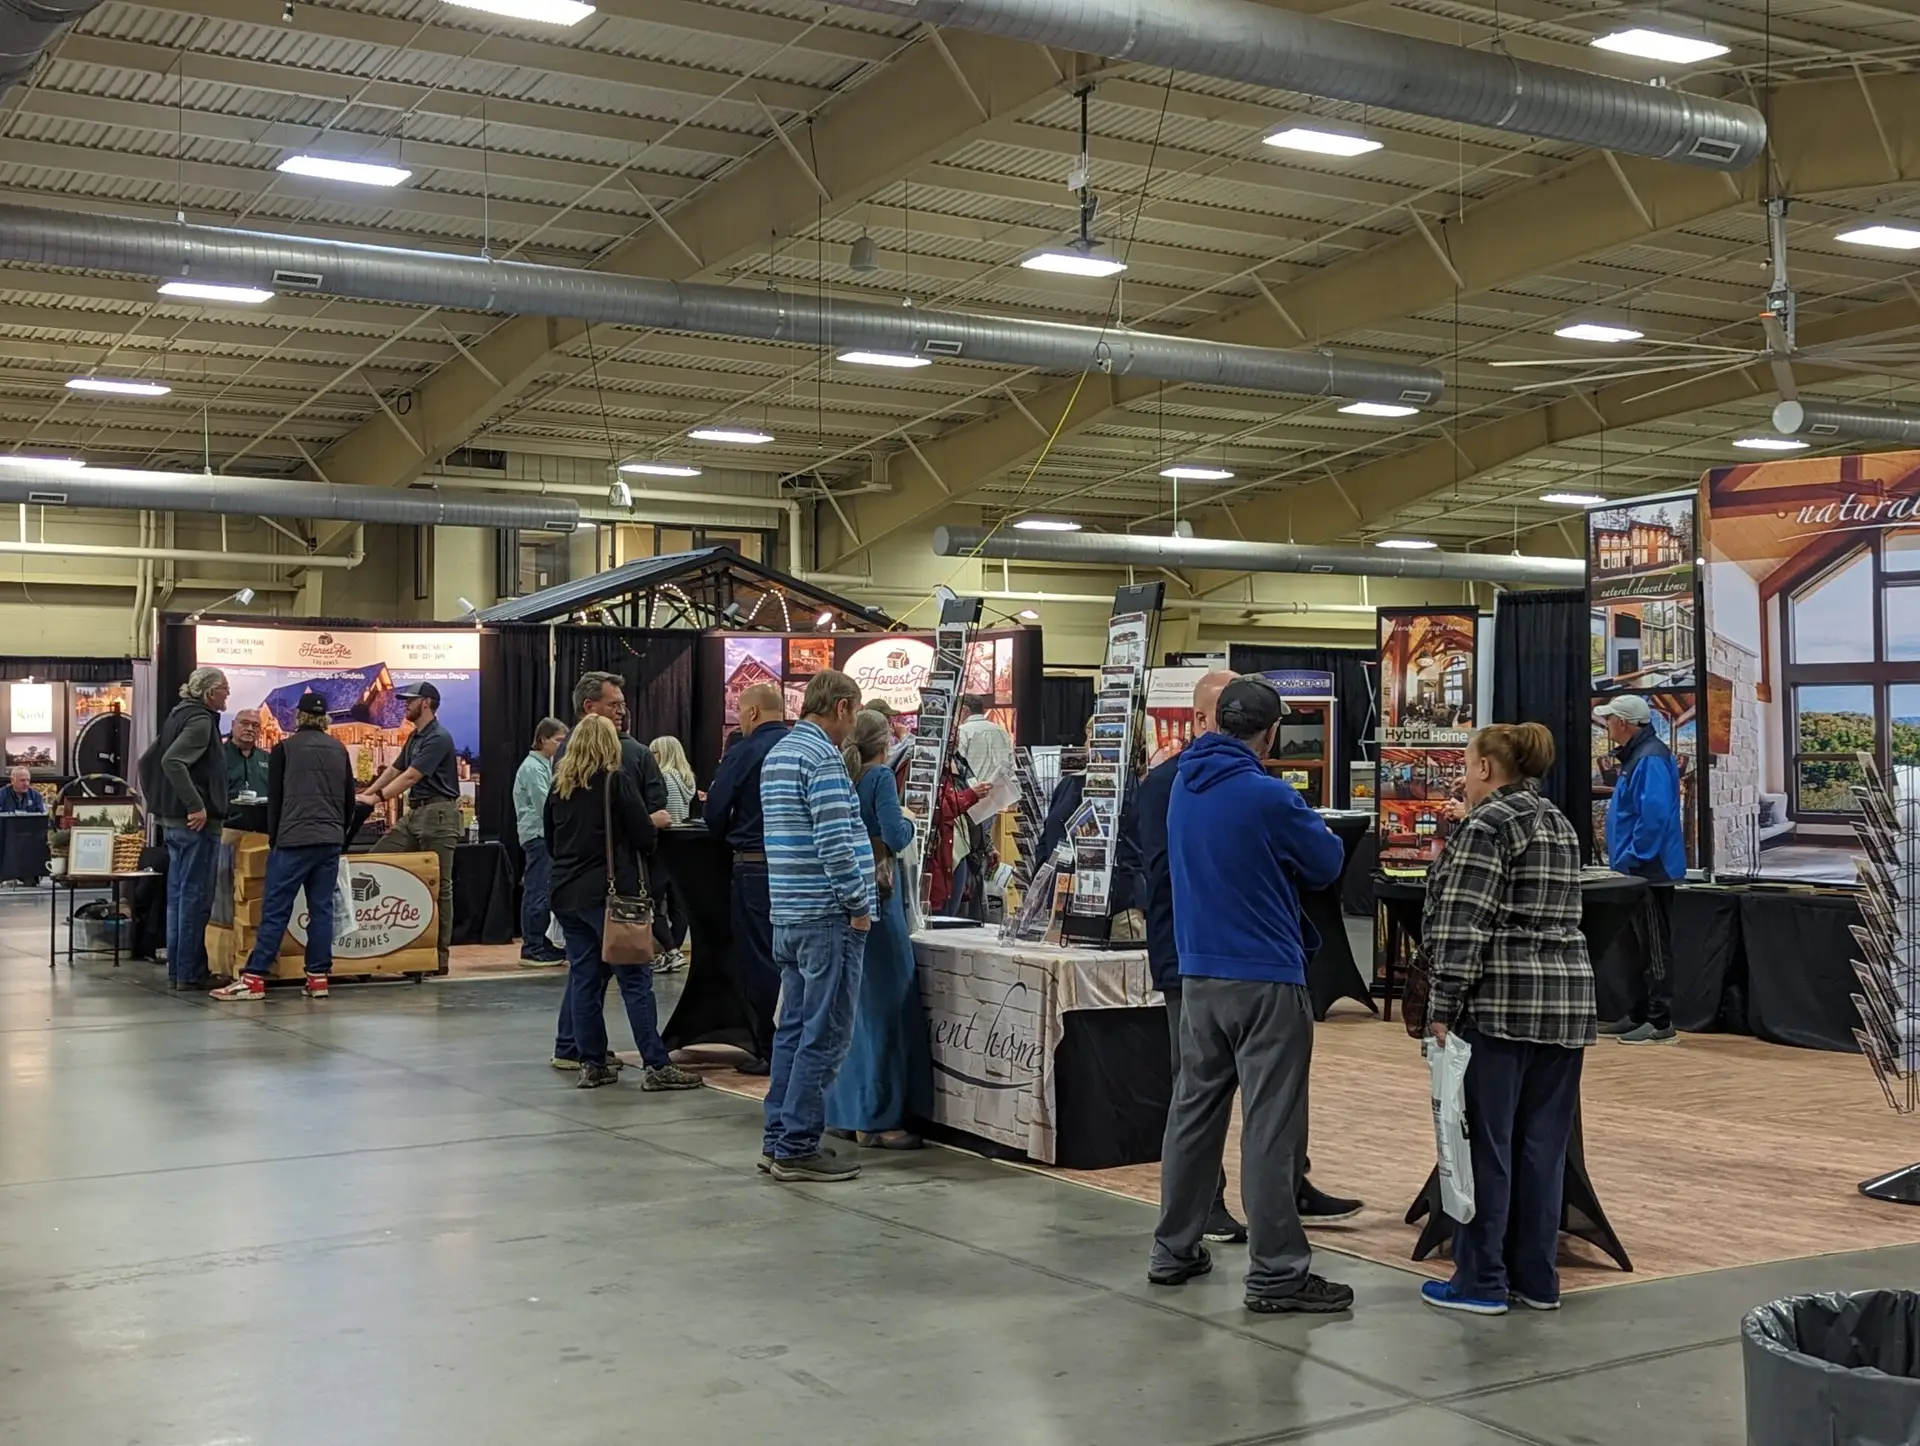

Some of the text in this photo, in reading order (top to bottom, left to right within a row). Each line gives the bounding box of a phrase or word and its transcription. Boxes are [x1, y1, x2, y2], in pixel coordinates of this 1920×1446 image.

[1601, 572, 1687, 597] natural element homes
[855, 667, 910, 690] Honest
[1298, 679, 1325, 687] DEPOT
[894, 693, 918, 705] HOMES
[1385, 728, 1469, 742] Hybrid Home
[381, 895, 420, 930] Abe
[332, 933, 390, 949] OG HOMES
